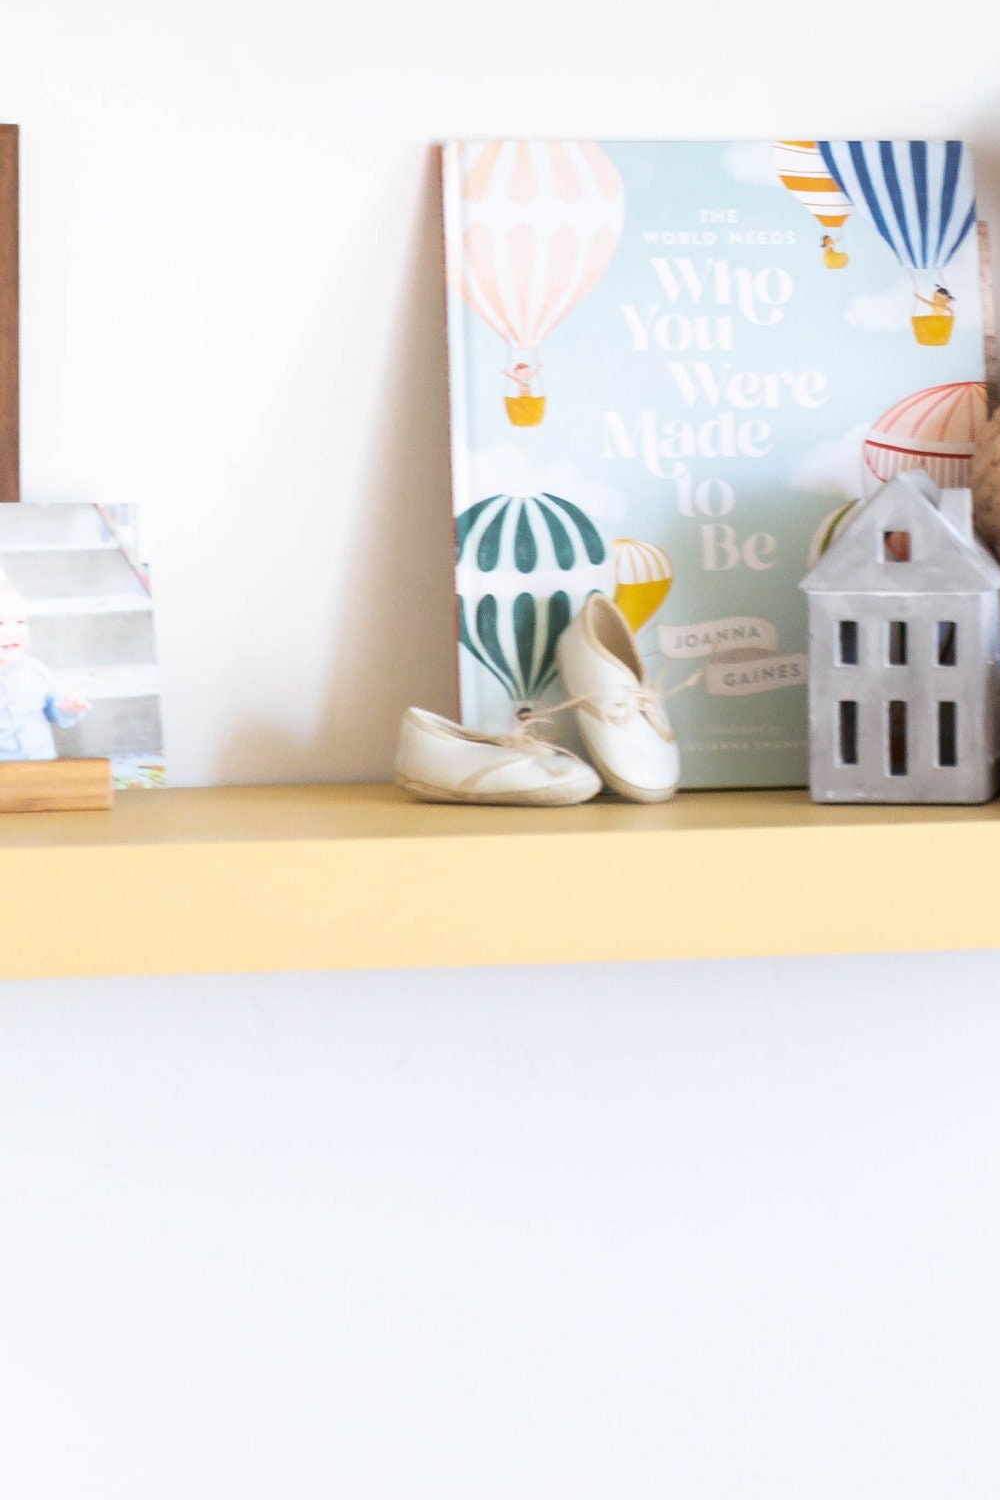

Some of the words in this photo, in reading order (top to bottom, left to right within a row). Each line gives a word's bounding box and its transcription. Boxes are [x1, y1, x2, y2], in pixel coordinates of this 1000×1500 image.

[642, 230, 720, 246] WORLD
[728, 230, 797, 246] NEEDS
[698, 209, 739, 224] THE
[650, 257, 795, 326] Who
[618, 303, 736, 352] You
[666, 361, 830, 410] Were
[601, 410, 774, 480] Made
[676, 466, 737, 518] to
[700, 522, 777, 572] Be
[673, 625, 762, 650] JOANNA
[721, 662, 801, 687] GAINES
